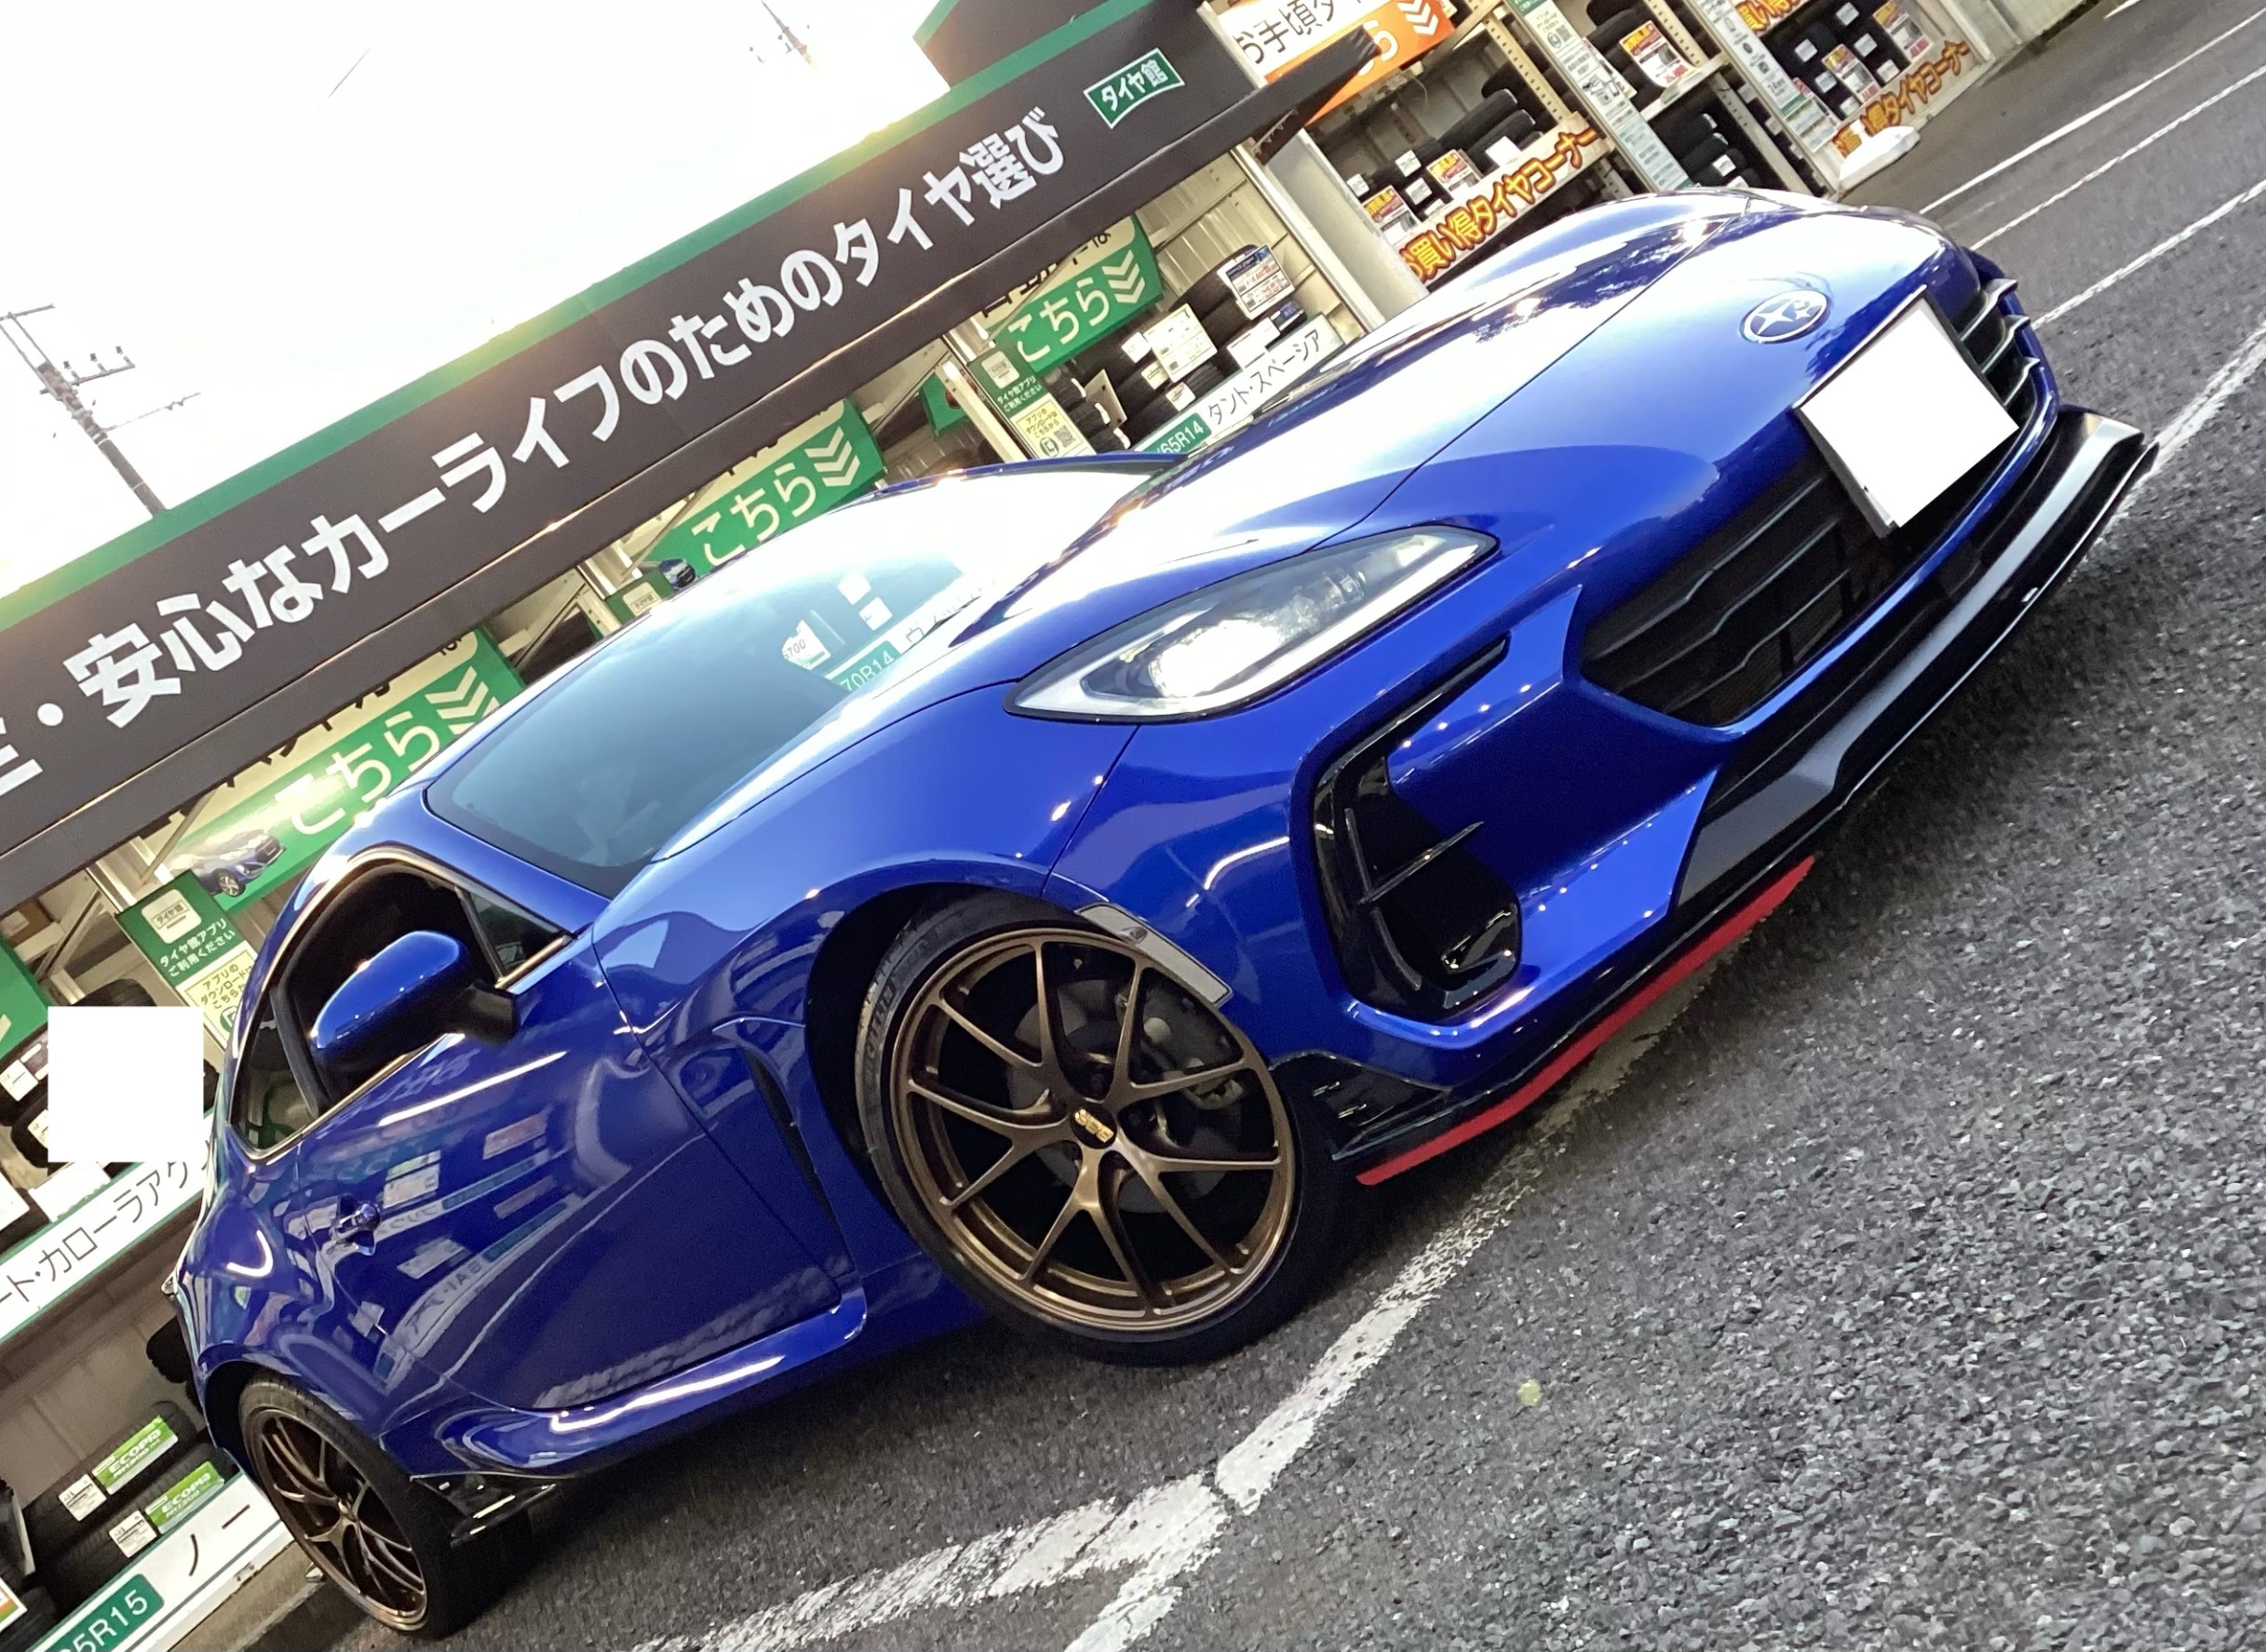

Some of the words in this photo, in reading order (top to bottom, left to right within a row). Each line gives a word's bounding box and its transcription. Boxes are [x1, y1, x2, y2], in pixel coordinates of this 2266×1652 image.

[1233, 0, 1362, 64] お手頃タ
[1100, 59, 1169, 112] タイヤ館
[1832, 40, 1971, 156] 買得タイヤコーナー
[1006, 276, 1111, 364] こちら
[1208, 329, 1320, 427] タント・スペーシア
[691, 463, 817, 566] こちら
[275, 710, 440, 835] こちら
[158, 917, 228, 967] タイヤ館アプリ
[168, 929, 236, 977] ご利用ください
[203, 963, 239, 990] アプリの
[211, 982, 245, 1010] こちらか
[1074, 1108, 1114, 1144] BBS
[60, 1589, 148, 1652] 5R15
